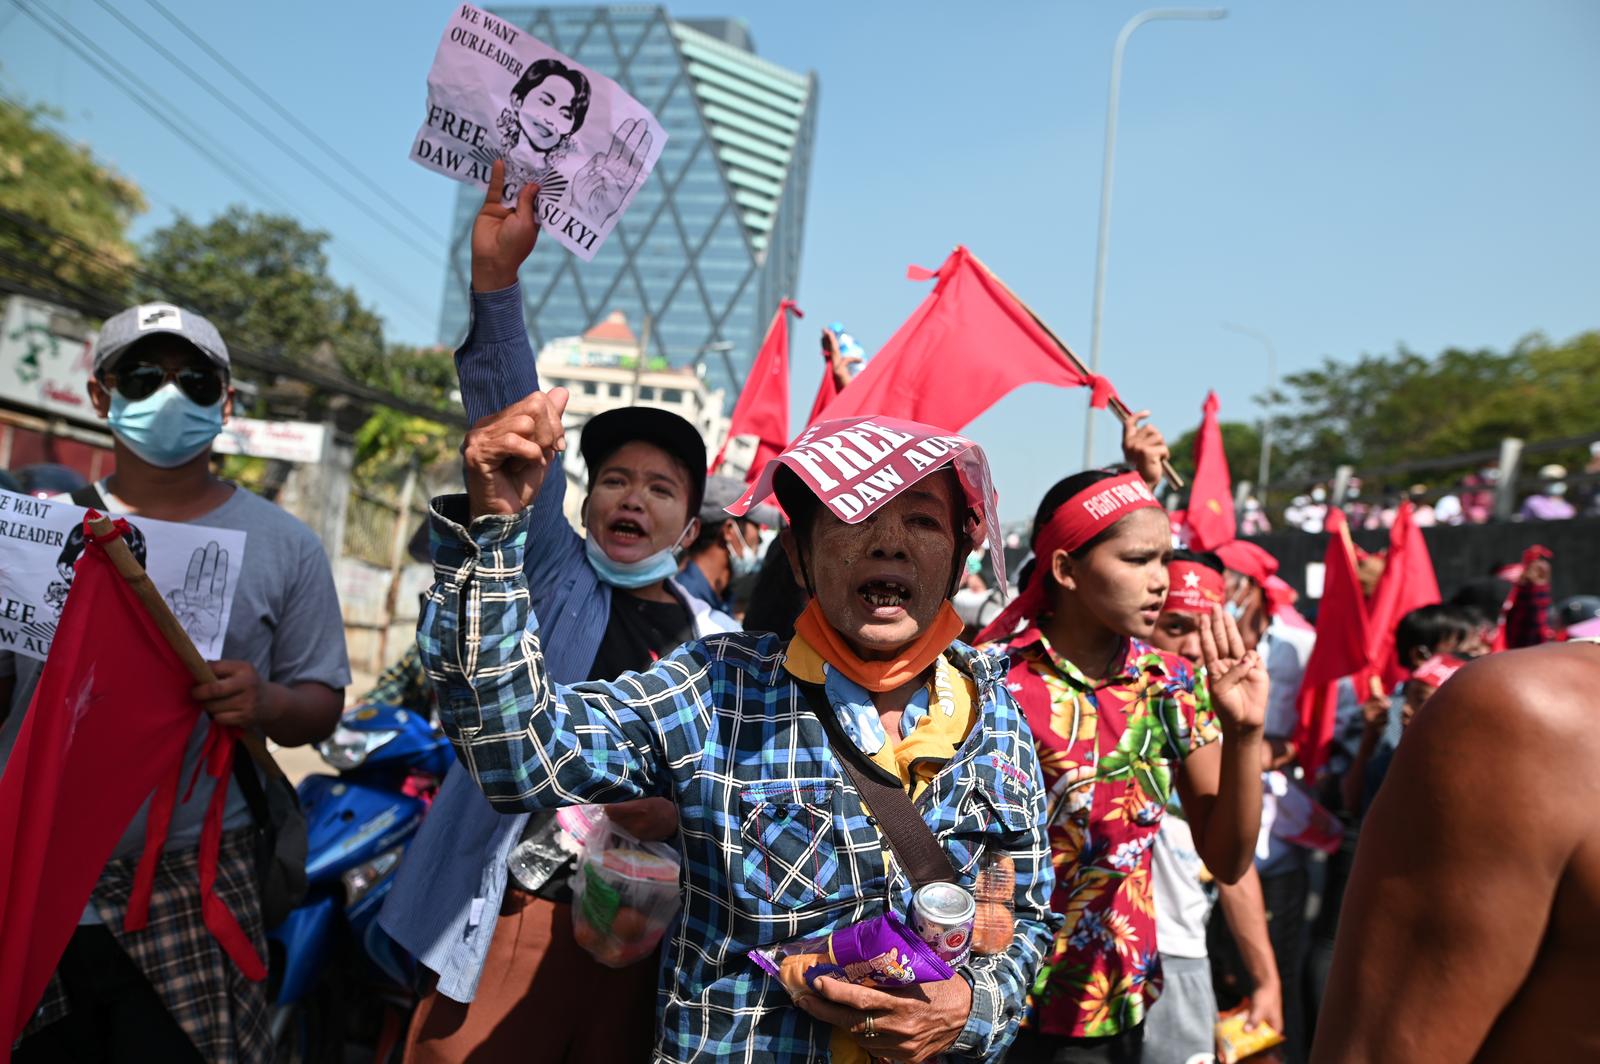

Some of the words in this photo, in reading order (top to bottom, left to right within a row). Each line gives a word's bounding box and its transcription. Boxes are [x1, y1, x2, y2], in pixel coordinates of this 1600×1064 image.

[461, 4, 480, 25] WE
[483, 16, 519, 46] WANT
[427, 103, 488, 151] FREE
[417, 138, 465, 172] DAW
[465, 160, 517, 202] AUG
[542, 202, 566, 226] SU
[561, 215, 600, 252] KYI
[781, 421, 916, 494] FREE
[13, 498, 53, 519] WANT
[828, 463, 905, 520] DAW
[1082, 489, 1122, 521] FIGHT
